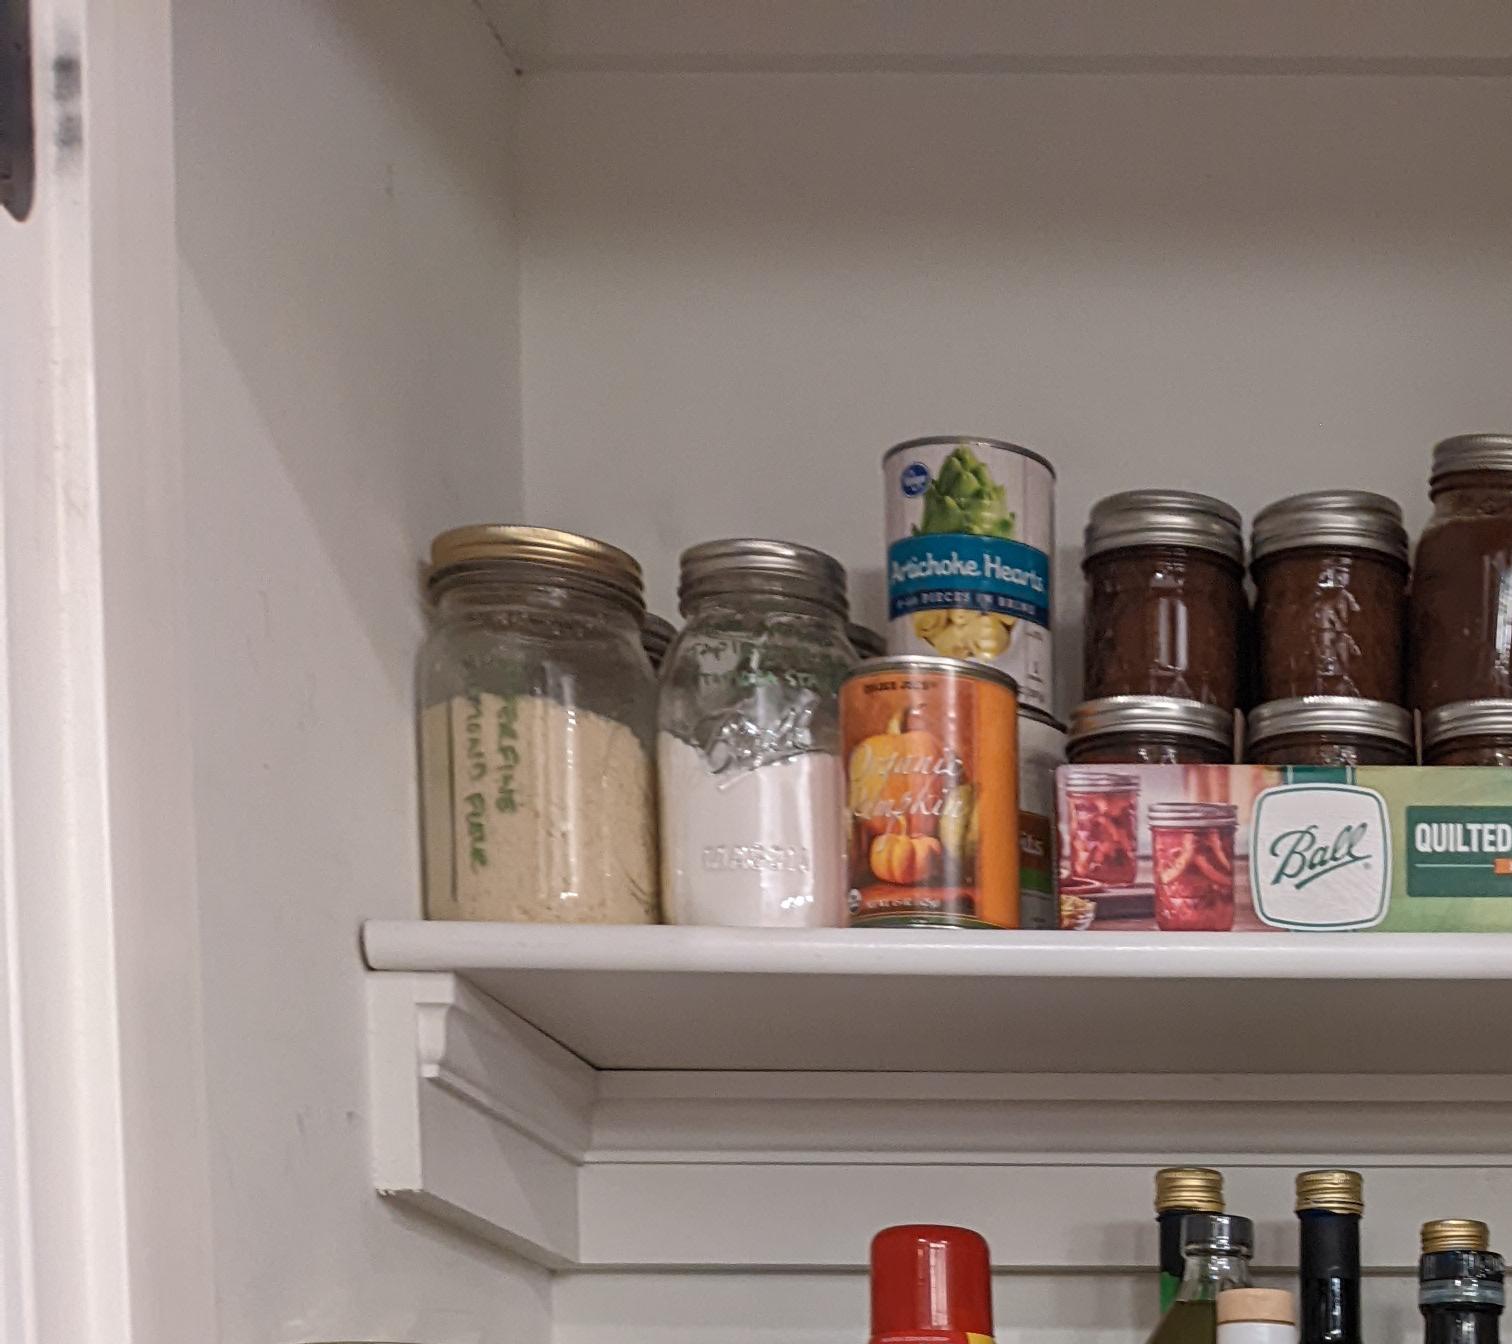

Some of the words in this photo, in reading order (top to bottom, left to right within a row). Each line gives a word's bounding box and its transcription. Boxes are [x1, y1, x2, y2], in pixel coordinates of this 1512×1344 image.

[891, 552, 982, 583] Artichoke
[983, 553, 1044, 592] Hearts
[1270, 822, 1370, 888] Ball
[1415, 823, 1512, 854] QUILTED
